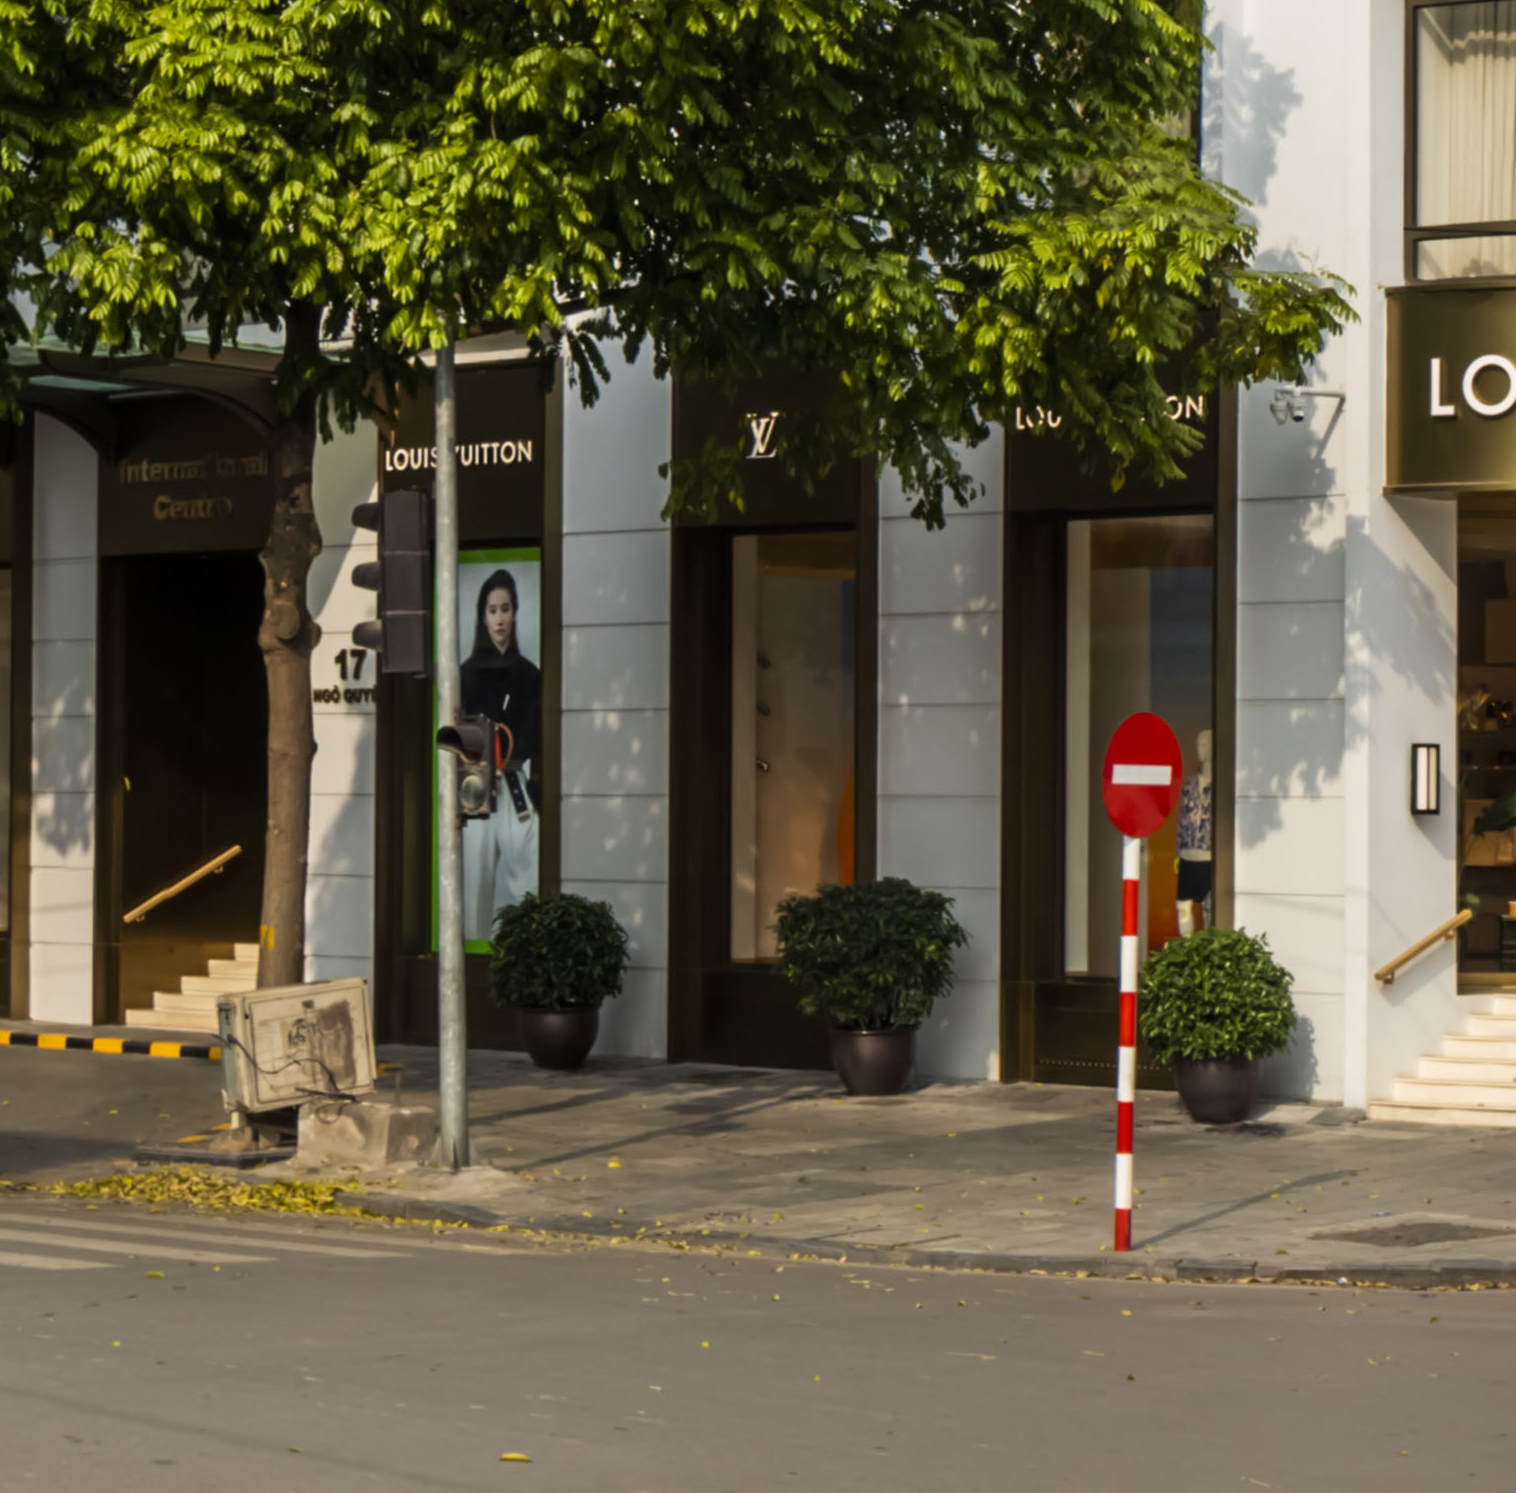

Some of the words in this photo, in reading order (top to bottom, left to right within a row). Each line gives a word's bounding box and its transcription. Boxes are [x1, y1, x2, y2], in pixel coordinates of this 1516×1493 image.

[385, 447, 437, 471] LOUIS
[455, 440, 532, 466] UITTON
[334, 648, 367, 680] 17
